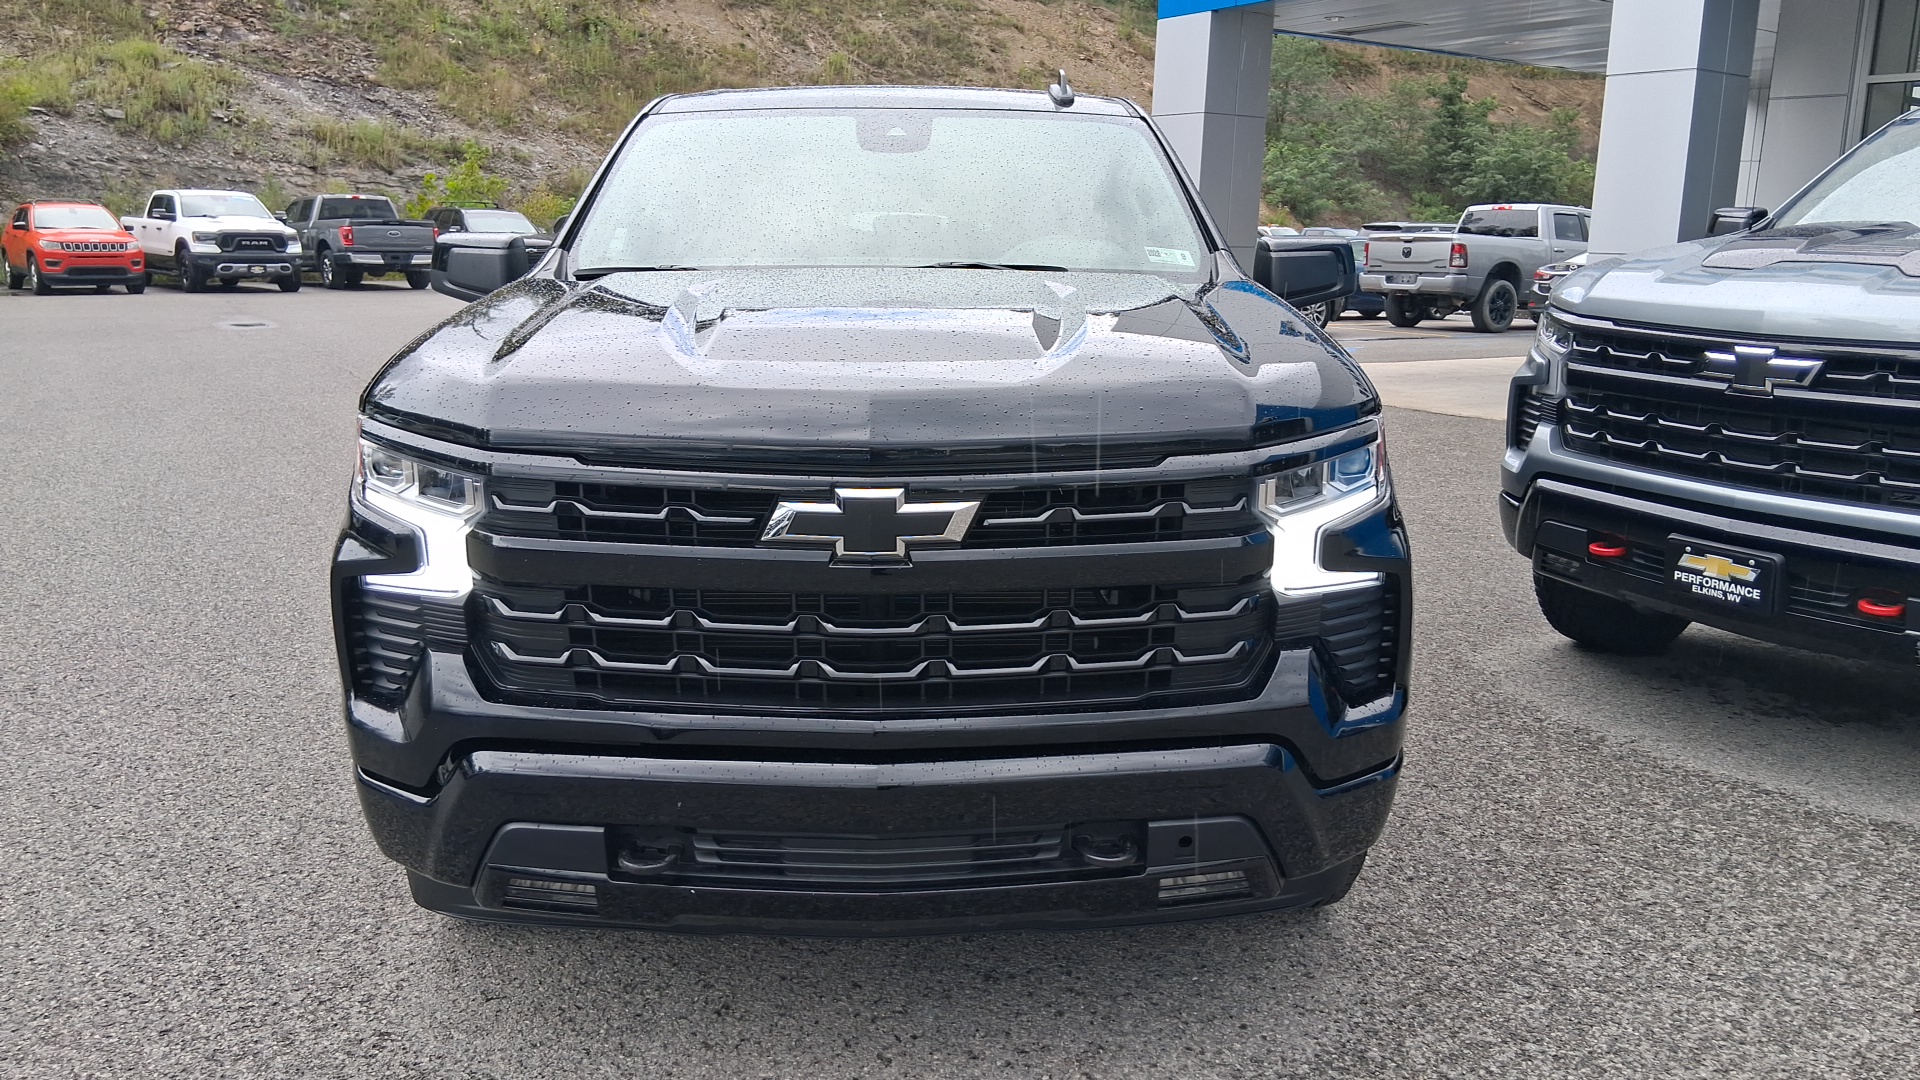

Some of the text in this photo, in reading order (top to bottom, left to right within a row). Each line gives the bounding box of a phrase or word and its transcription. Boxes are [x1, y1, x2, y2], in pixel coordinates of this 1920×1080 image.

[1673, 570, 1761, 600] PERFORMANCE
[1691, 585, 1742, 603] ELKINS, WV
